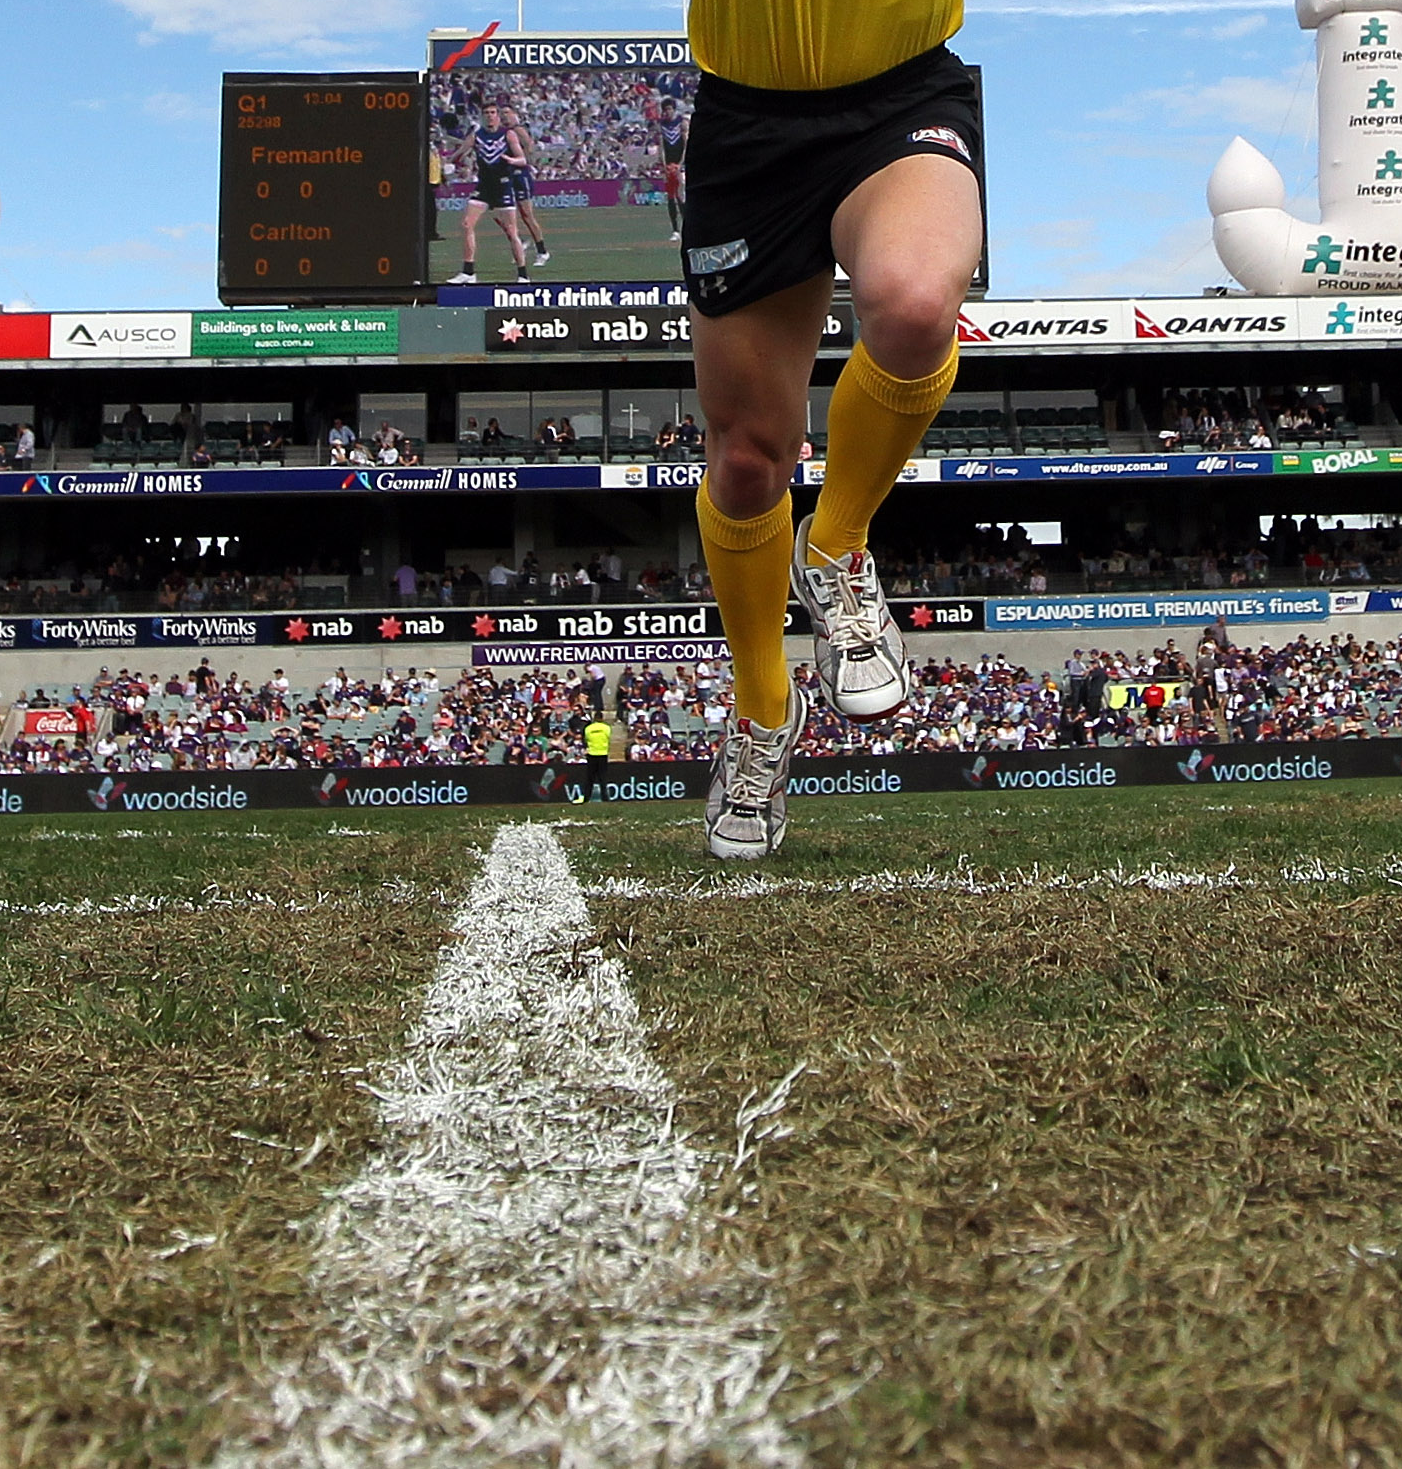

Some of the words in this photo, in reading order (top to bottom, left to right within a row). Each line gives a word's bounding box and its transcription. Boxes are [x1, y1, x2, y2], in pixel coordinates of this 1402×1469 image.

[483, 43, 618, 65] PATERSONS
[625, 42, 690, 64] STADI
[238, 95, 267, 113] Q1
[364, 92, 410, 110] 0:00
[251, 146, 363, 164] Fremantle
[256, 182, 270, 198] 0
[300, 181, 313, 198] 0
[378, 181, 392, 198] 0
[249, 223, 332, 241] Carlton
[255, 259, 269, 275] 0
[299, 258, 312, 275] 0
[377, 257, 391, 274] 0
[1318, 279, 1370, 290] PROUD
[494, 286, 552, 307] Don't
[558, 286, 612, 307] drink
[619, 285, 660, 307] and
[98, 328, 177, 342] AUSCO
[200, 321, 258, 336] Buildings
[260, 322, 274, 333] to
[277, 320, 302, 334] live,
[305, 320, 337, 332] work
[340, 320, 352, 332] &
[355, 319, 386, 332] learn
[527, 318, 569, 339] nab
[592, 316, 648, 341] nab
[989, 318, 1109, 340] QANTAS
[1165, 315, 1287, 337] QANTAS
[1041, 460, 1168, 475] www.dtegroup.com.au
[1311, 449, 1378, 474] BORAL
[58, 472, 139, 495] Gemmill
[144, 474, 202, 492] HOMES
[376, 468, 452, 491] Gemmill
[458, 470, 517, 489] HOMES
[656, 466, 701, 486] RCR
[936, 604, 973, 623] nab
[996, 603, 1095, 621] ESPLANADE
[1098, 601, 1151, 619] HOTEL
[1154, 599, 1265, 617] FREMANTLE's
[1270, 597, 1323, 614] finest.
[42, 619, 137, 642] FortyWinks
[162, 618, 257, 640] FortyWinks
[312, 616, 353, 637] nab
[405, 615, 444, 634] nab
[499, 614, 537, 632] nab
[559, 610, 613, 637] nab
[624, 607, 706, 635] stand
[0, 638, 14, 647] bed
[97, 637, 120, 647] better
[121, 636, 135, 646] bed
[218, 635, 240, 645] better
[241, 635, 256, 644] bed
[485, 643, 732, 664] WWW.FREMANTLEFC.COM.A
[997, 762, 1116, 788] woodside
[1212, 755, 1332, 782] woodside
[786, 768, 901, 795] woodside
[123, 785, 248, 810] woodside
[345, 779, 468, 806] woodside
